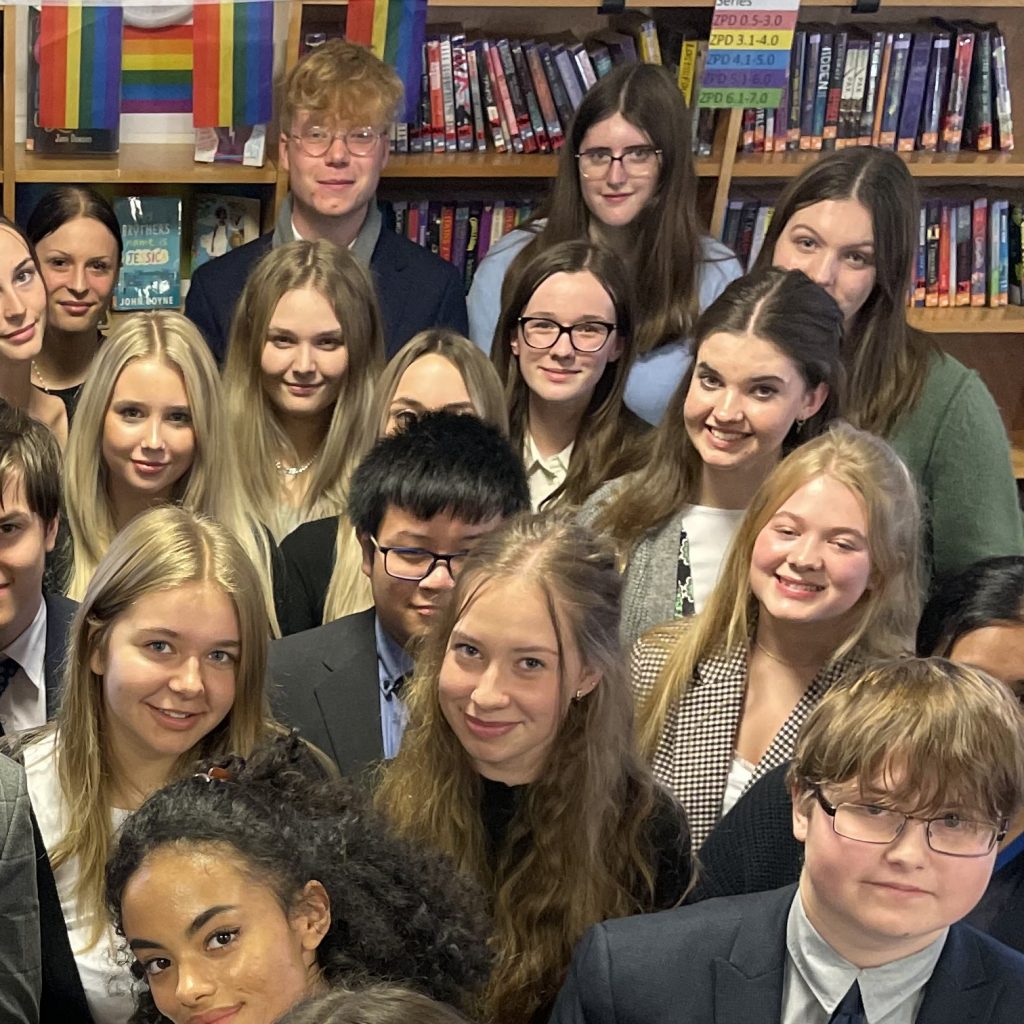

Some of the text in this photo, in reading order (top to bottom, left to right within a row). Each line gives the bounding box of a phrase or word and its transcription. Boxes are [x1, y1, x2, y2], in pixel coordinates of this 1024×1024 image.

[713, 14, 783, 26] ZPD 0.5-3.0
[709, 34, 779, 46] ZPD 3.1-4.0
[707, 54, 775, 66] ZPD 4.1-5.0
[855, 77, 863, 94] PAX
[699, 92, 768, 104] ZPD 6.1-7.0
[119, 297, 143, 307] JOHN
